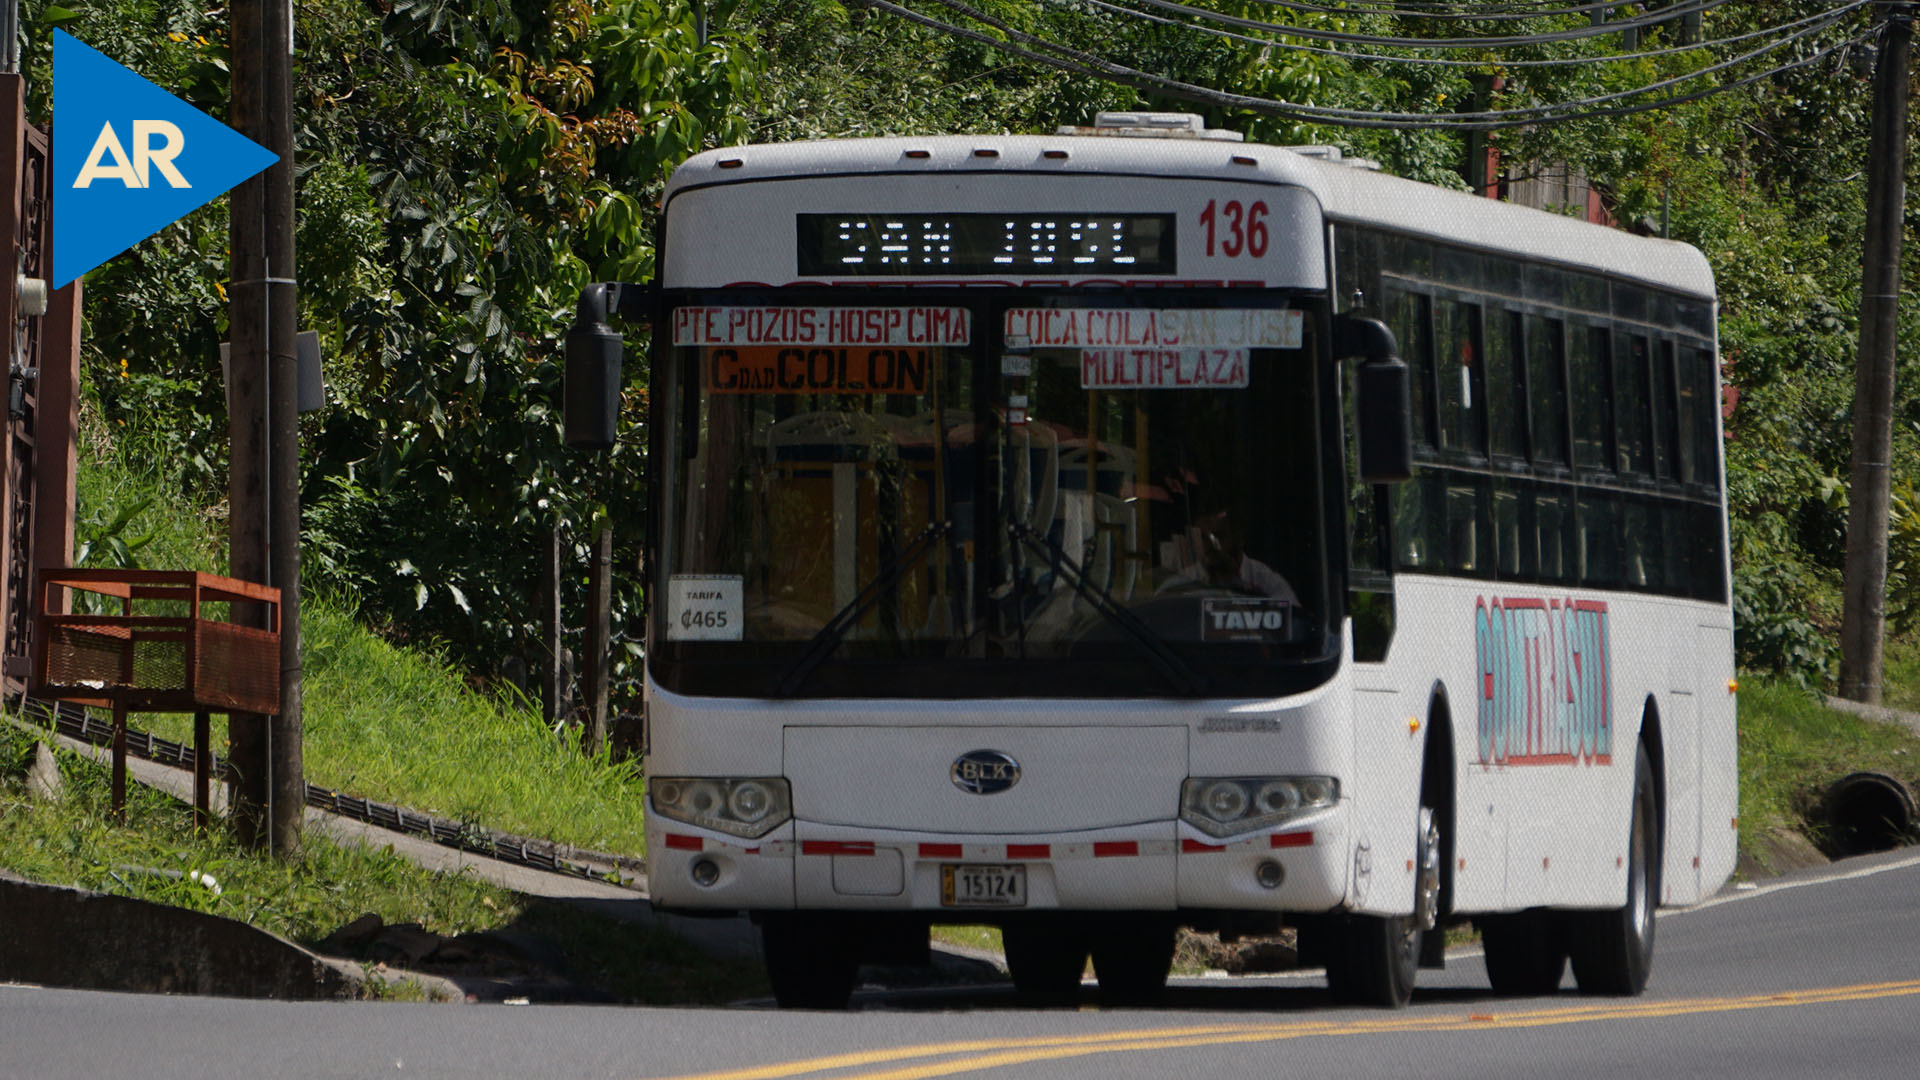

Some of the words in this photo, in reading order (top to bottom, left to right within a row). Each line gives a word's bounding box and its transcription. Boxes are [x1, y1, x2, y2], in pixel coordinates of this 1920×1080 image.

[1199, 199, 1269, 258] 136
[1006, 309, 1079, 345] COCA
[1087, 310, 1158, 346] COLA
[1082, 350, 1246, 386] MULTIPLAZA
[686, 591, 723, 600] TARIFA
[1210, 611, 1283, 630] TAVO
[963, 875, 1017, 897] 15124
